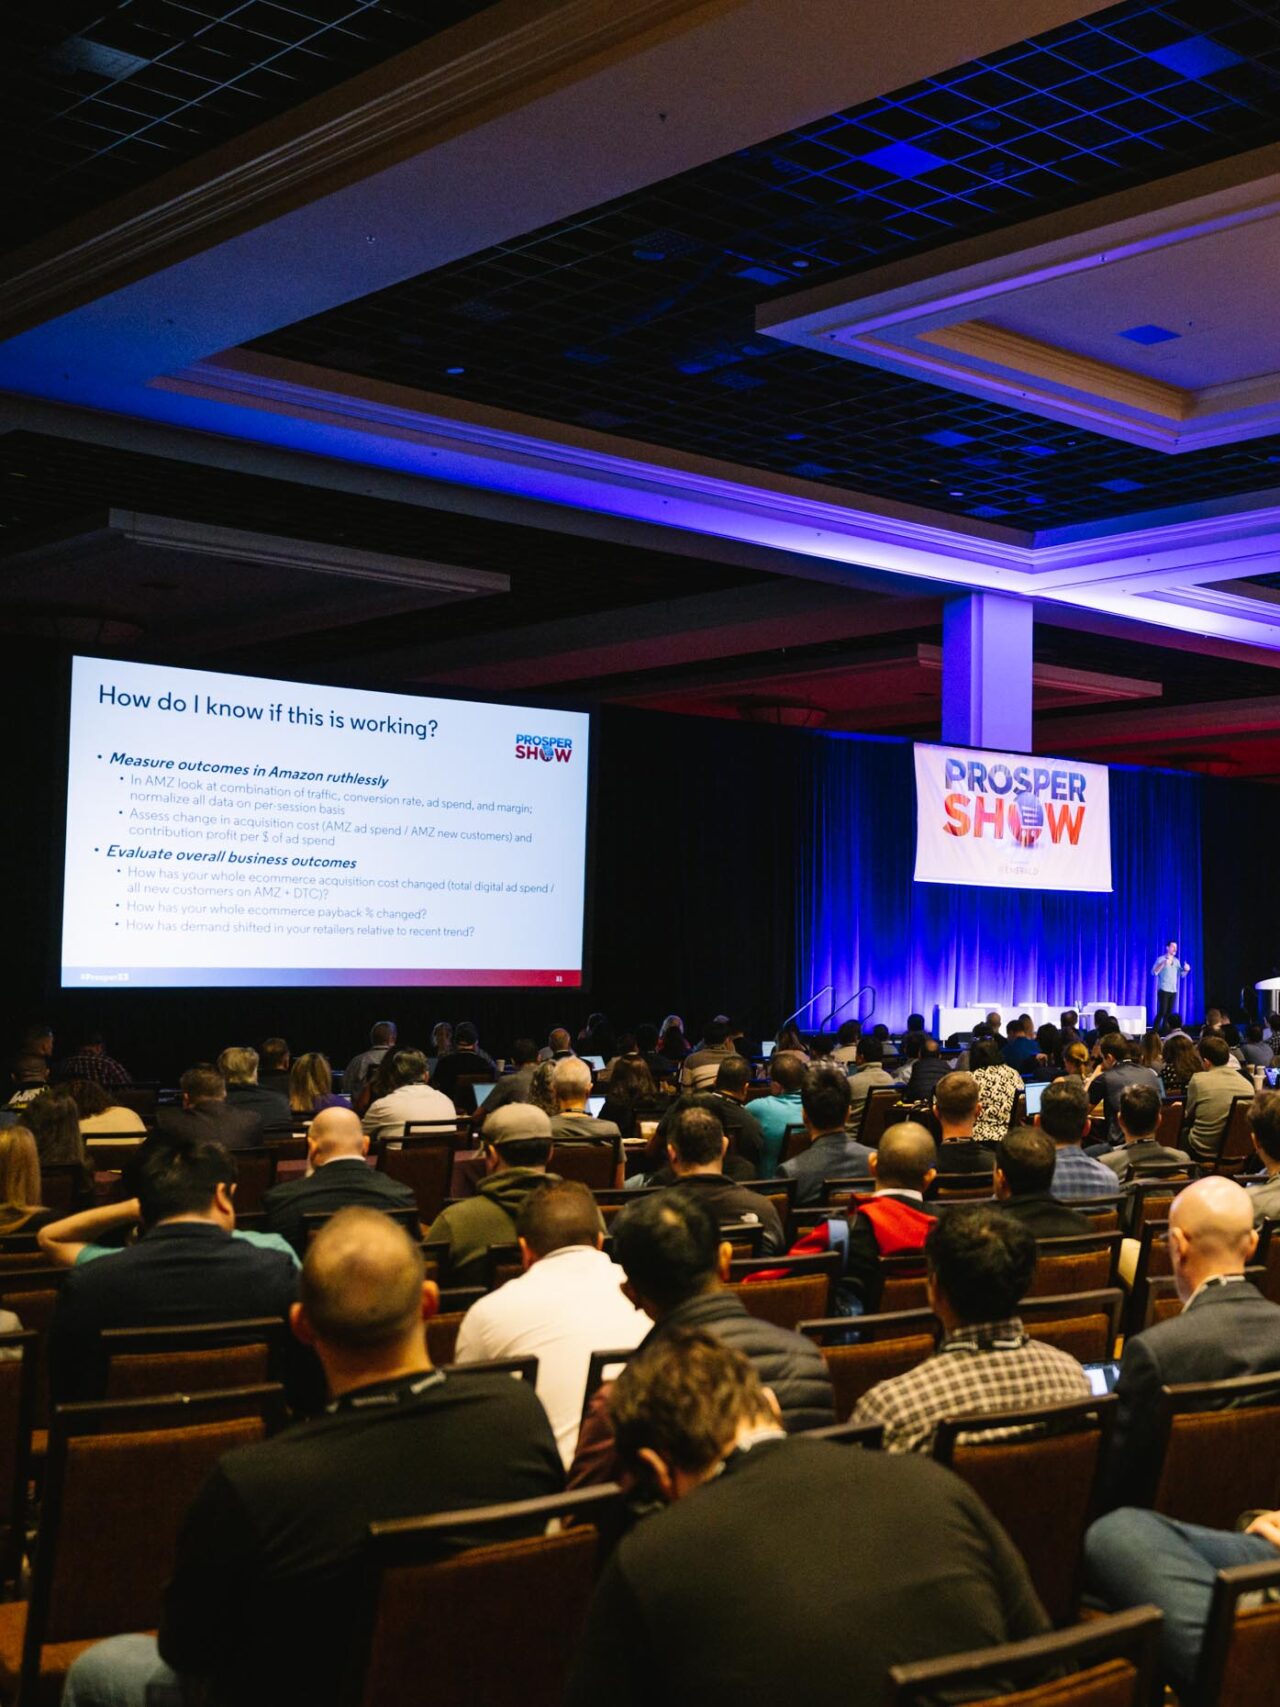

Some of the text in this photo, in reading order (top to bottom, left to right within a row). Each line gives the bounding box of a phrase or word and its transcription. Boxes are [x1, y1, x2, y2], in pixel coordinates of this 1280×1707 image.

[99, 684, 439, 741] How do I know if this is working?
[516, 734, 573, 748] PROSPER
[515, 745, 573, 763] SHOW
[110, 752, 390, 789] Measure outcomes in Amazon ruthlessly
[945, 758, 1087, 802] PROSPER
[130, 791, 190, 805] normalize
[192, 795, 205, 805] all
[208, 796, 234, 808] data
[236, 800, 251, 808] on
[319, 804, 345, 815] basis
[131, 774, 533, 815] In AMZ look at combination of traffic, conversion rate, ad spend, and margin;
[129, 808, 170, 821] Assess
[172, 812, 217, 826] change
[220, 815, 230, 825] in
[233, 816, 294, 829] acquisition
[297, 821, 319, 831] cost
[322, 821, 352, 833] (AMZ
[354, 824, 367, 834] ad
[370, 825, 401, 836] spend
[411, 826, 435, 837] AMZ
[437, 830, 458, 839] new
[460, 831, 513, 843] customers)
[515, 834, 532, 843] and
[943, 793, 1086, 849] SHOW
[129, 826, 335, 846] contribution profit per $ of ad spend
[106, 844, 357, 869] Evaluate overall business outcomes
[127, 866, 158, 878] How
[160, 868, 179, 879] has
[182, 871, 208, 882] your
[211, 871, 246, 882] whole
[249, 874, 316, 885] ecommerce
[318, 876, 375, 888] acquisition
[377, 879, 399, 888] cost
[401, 878, 445, 891] changed
[448, 880, 472, 892] (total
[474, 881, 503, 893] digital
[520, 883, 548, 894] spend
[127, 882, 140, 893] all
[144, 885, 169, 894] new
[172, 886, 234, 896] customers
[254, 887, 281, 898] AMZ
[294, 887, 329, 900] DTC)?
[127, 900, 159, 913] How
[158, 903, 178, 913] has
[181, 906, 206, 915] your
[210, 904, 244, 915] whole
[248, 907, 315, 916] ecommerce
[318, 908, 362, 919] payback
[376, 908, 427, 920] changed?
[126, 920, 157, 931] How
[158, 922, 177, 932] has
[181, 922, 230, 933] demand
[233, 923, 271, 934] shifted
[287, 926, 311, 936] your
[313, 925, 354, 935] retailers
[357, 925, 394, 936] relative
[409, 928, 441, 936] recent
[443, 927, 475, 937] trend?
